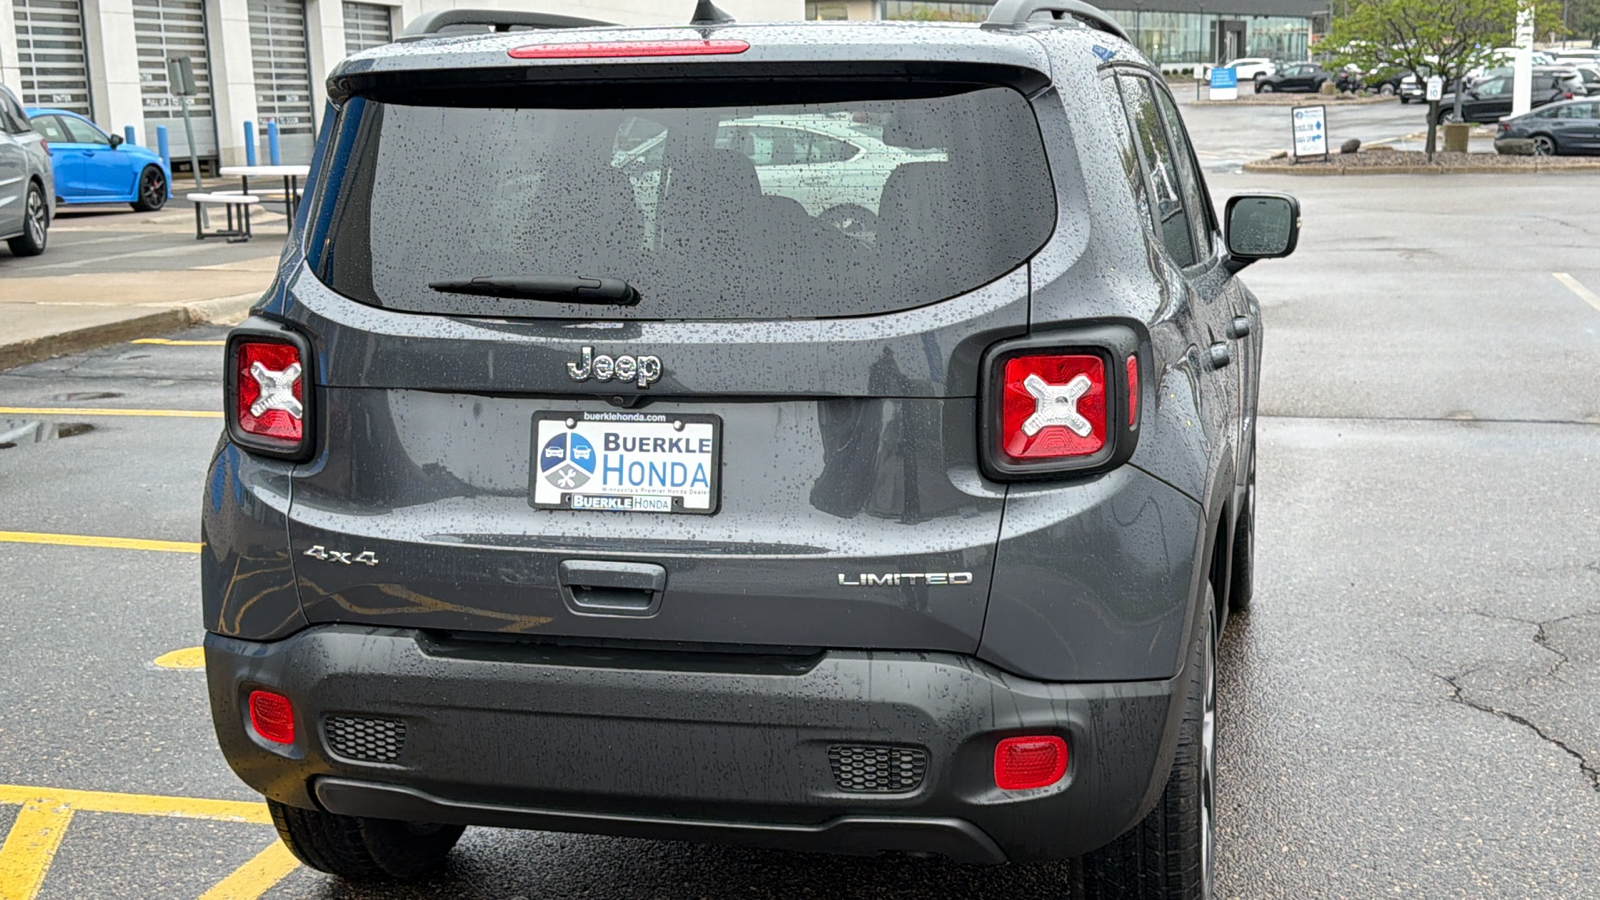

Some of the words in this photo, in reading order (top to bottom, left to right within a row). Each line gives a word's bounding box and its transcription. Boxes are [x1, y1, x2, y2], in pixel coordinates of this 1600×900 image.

[566, 346, 662, 388] Jeep
[584, 412, 666, 422] buerklehonda.com
[604, 433, 711, 453] BUERKLE
[602, 454, 709, 488] HONDA
[573, 495, 633, 509] BUERKLE
[634, 496, 669, 510] HONDA
[303, 545, 379, 566] 4x4
[838, 572, 973, 585] LIMITED
